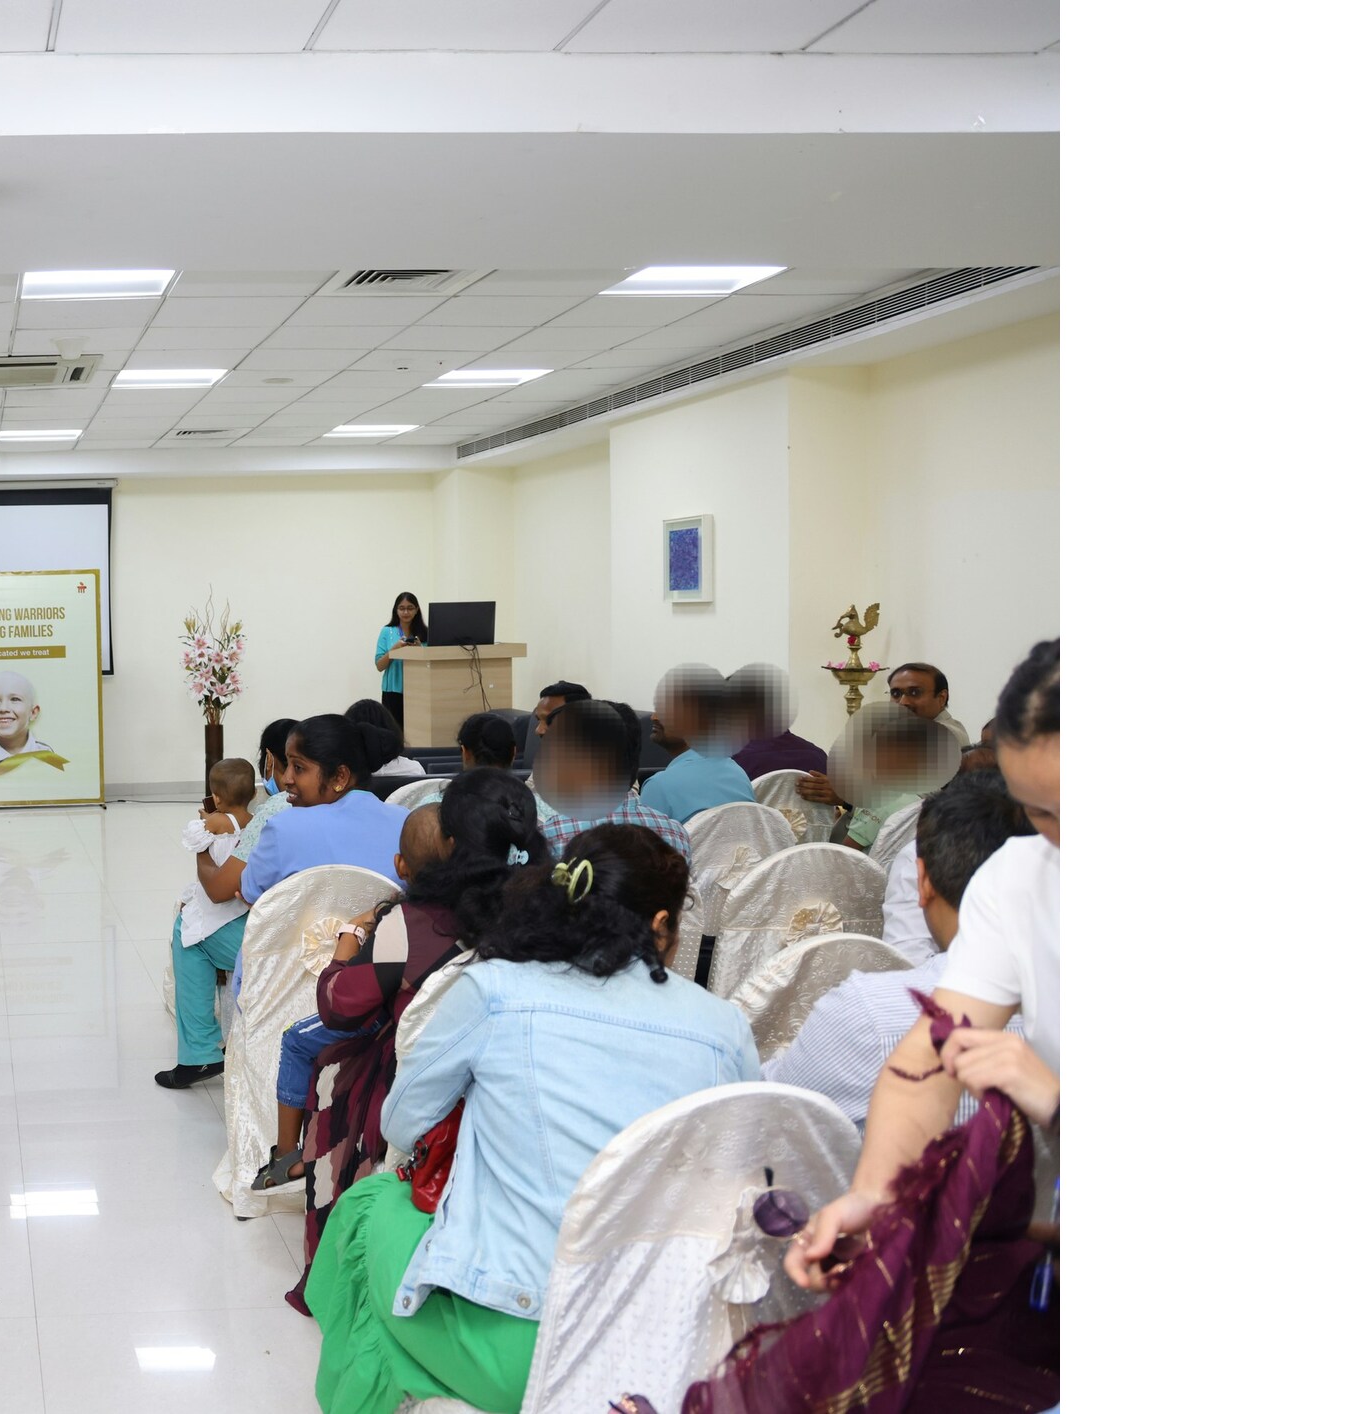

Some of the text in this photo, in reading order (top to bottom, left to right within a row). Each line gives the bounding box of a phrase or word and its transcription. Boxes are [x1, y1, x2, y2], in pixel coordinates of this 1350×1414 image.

[14, 606, 65, 620] WARRIORS
[8, 624, 54, 638] FAMILIES
[32, 648, 50, 656] treat
